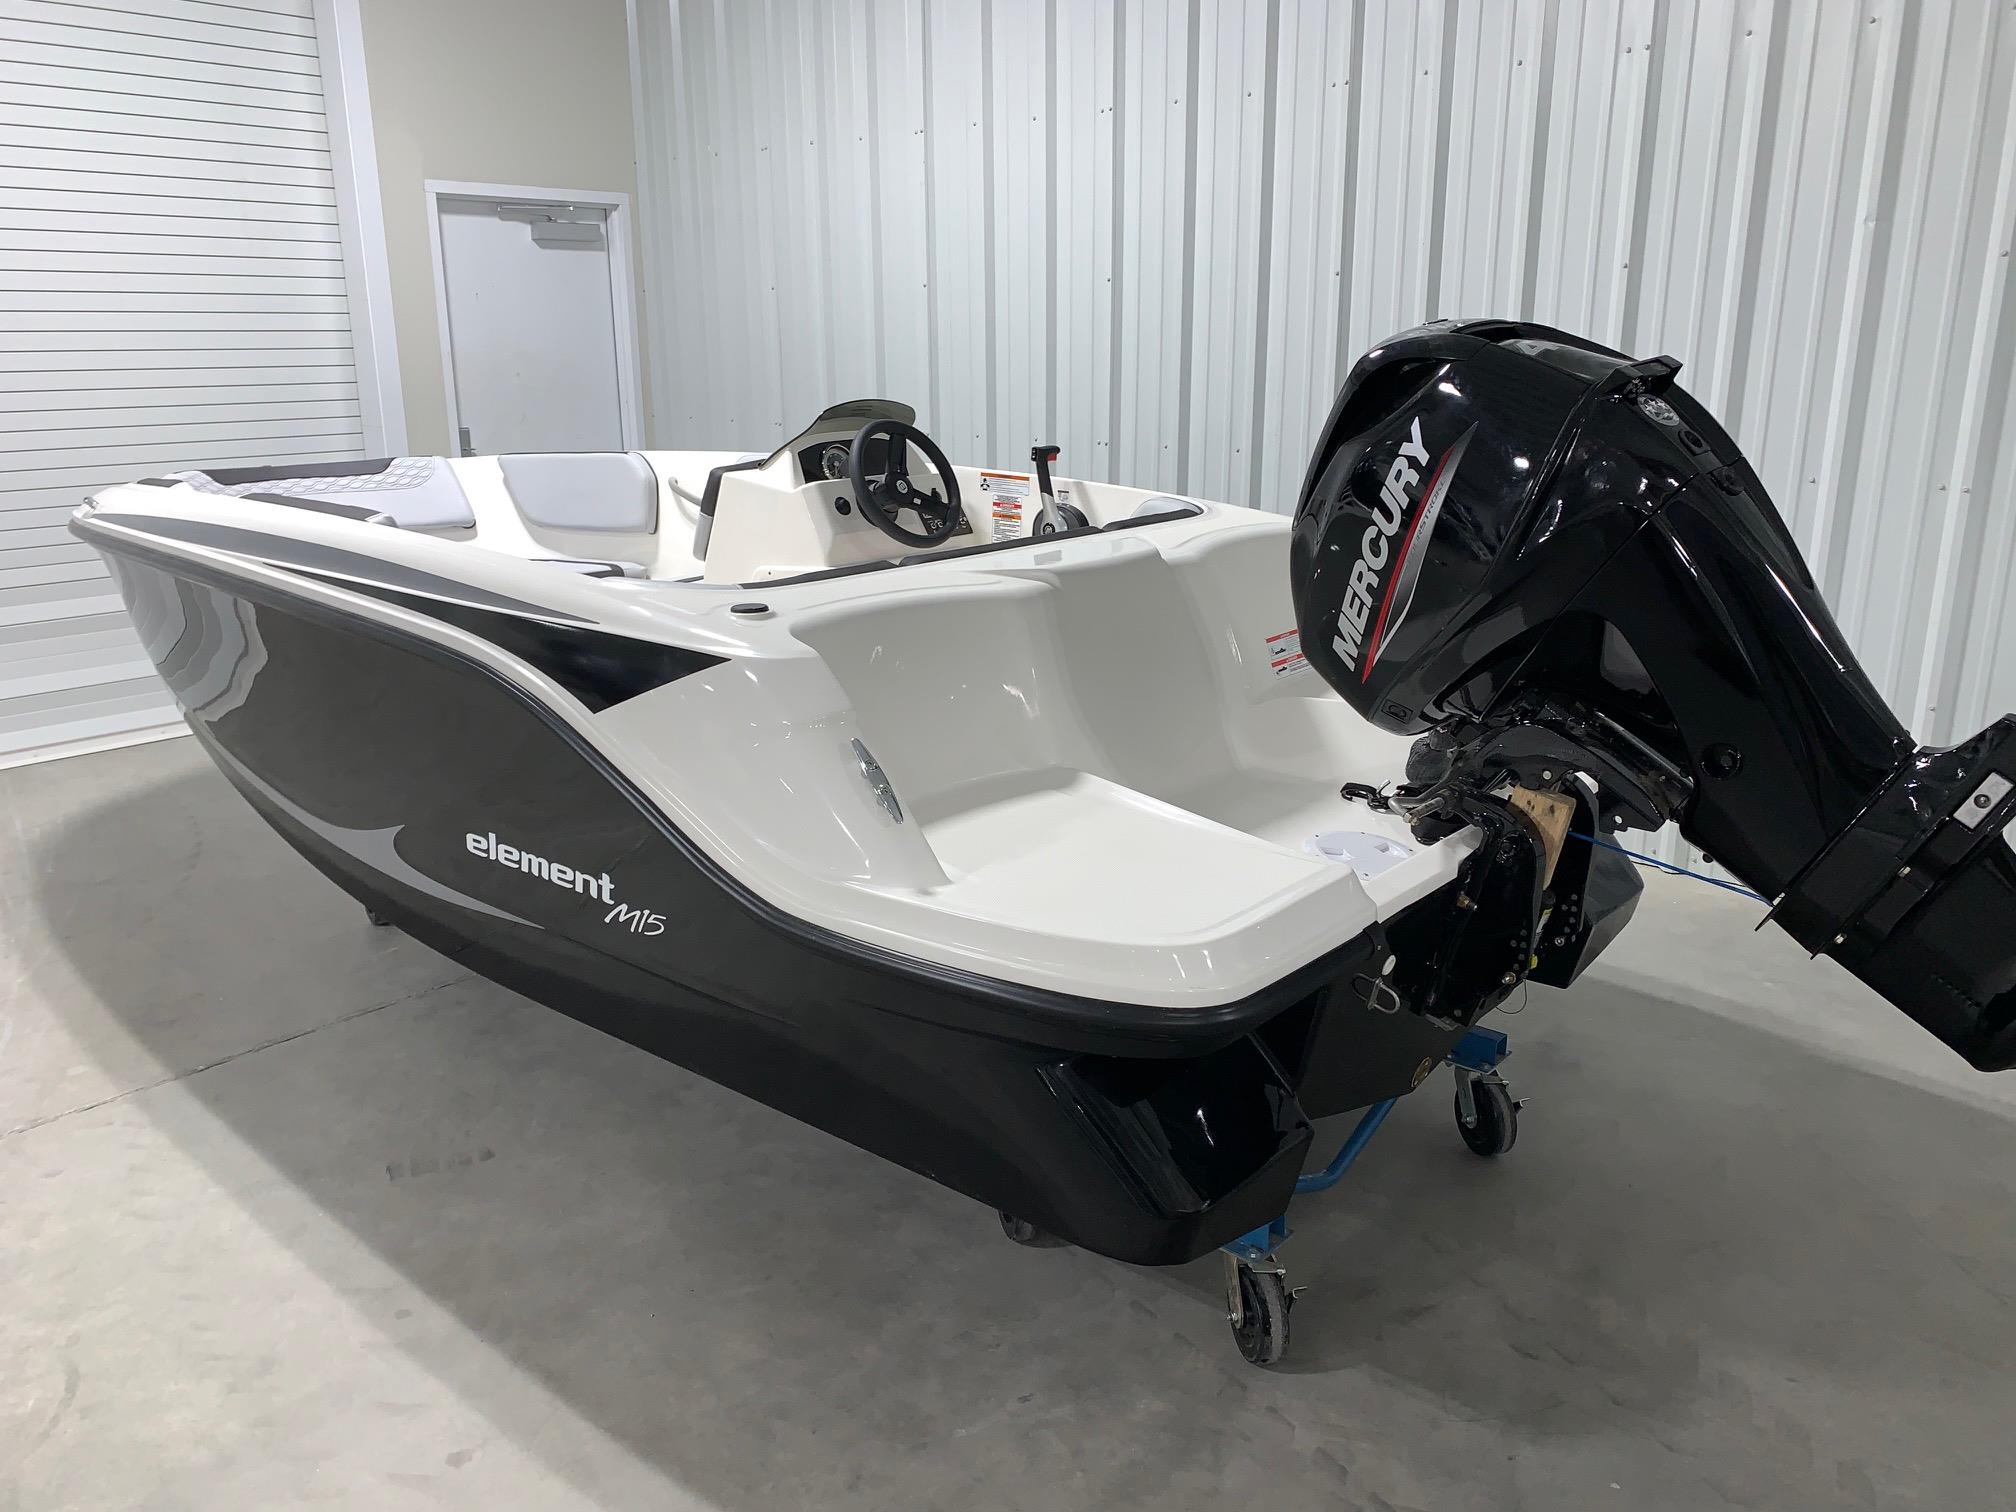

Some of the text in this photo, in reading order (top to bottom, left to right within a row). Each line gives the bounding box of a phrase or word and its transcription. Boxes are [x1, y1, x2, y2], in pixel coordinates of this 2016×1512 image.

[1332, 416, 1431, 671] MERCURY
[465, 831, 615, 905] element
[603, 903, 667, 936] M15
